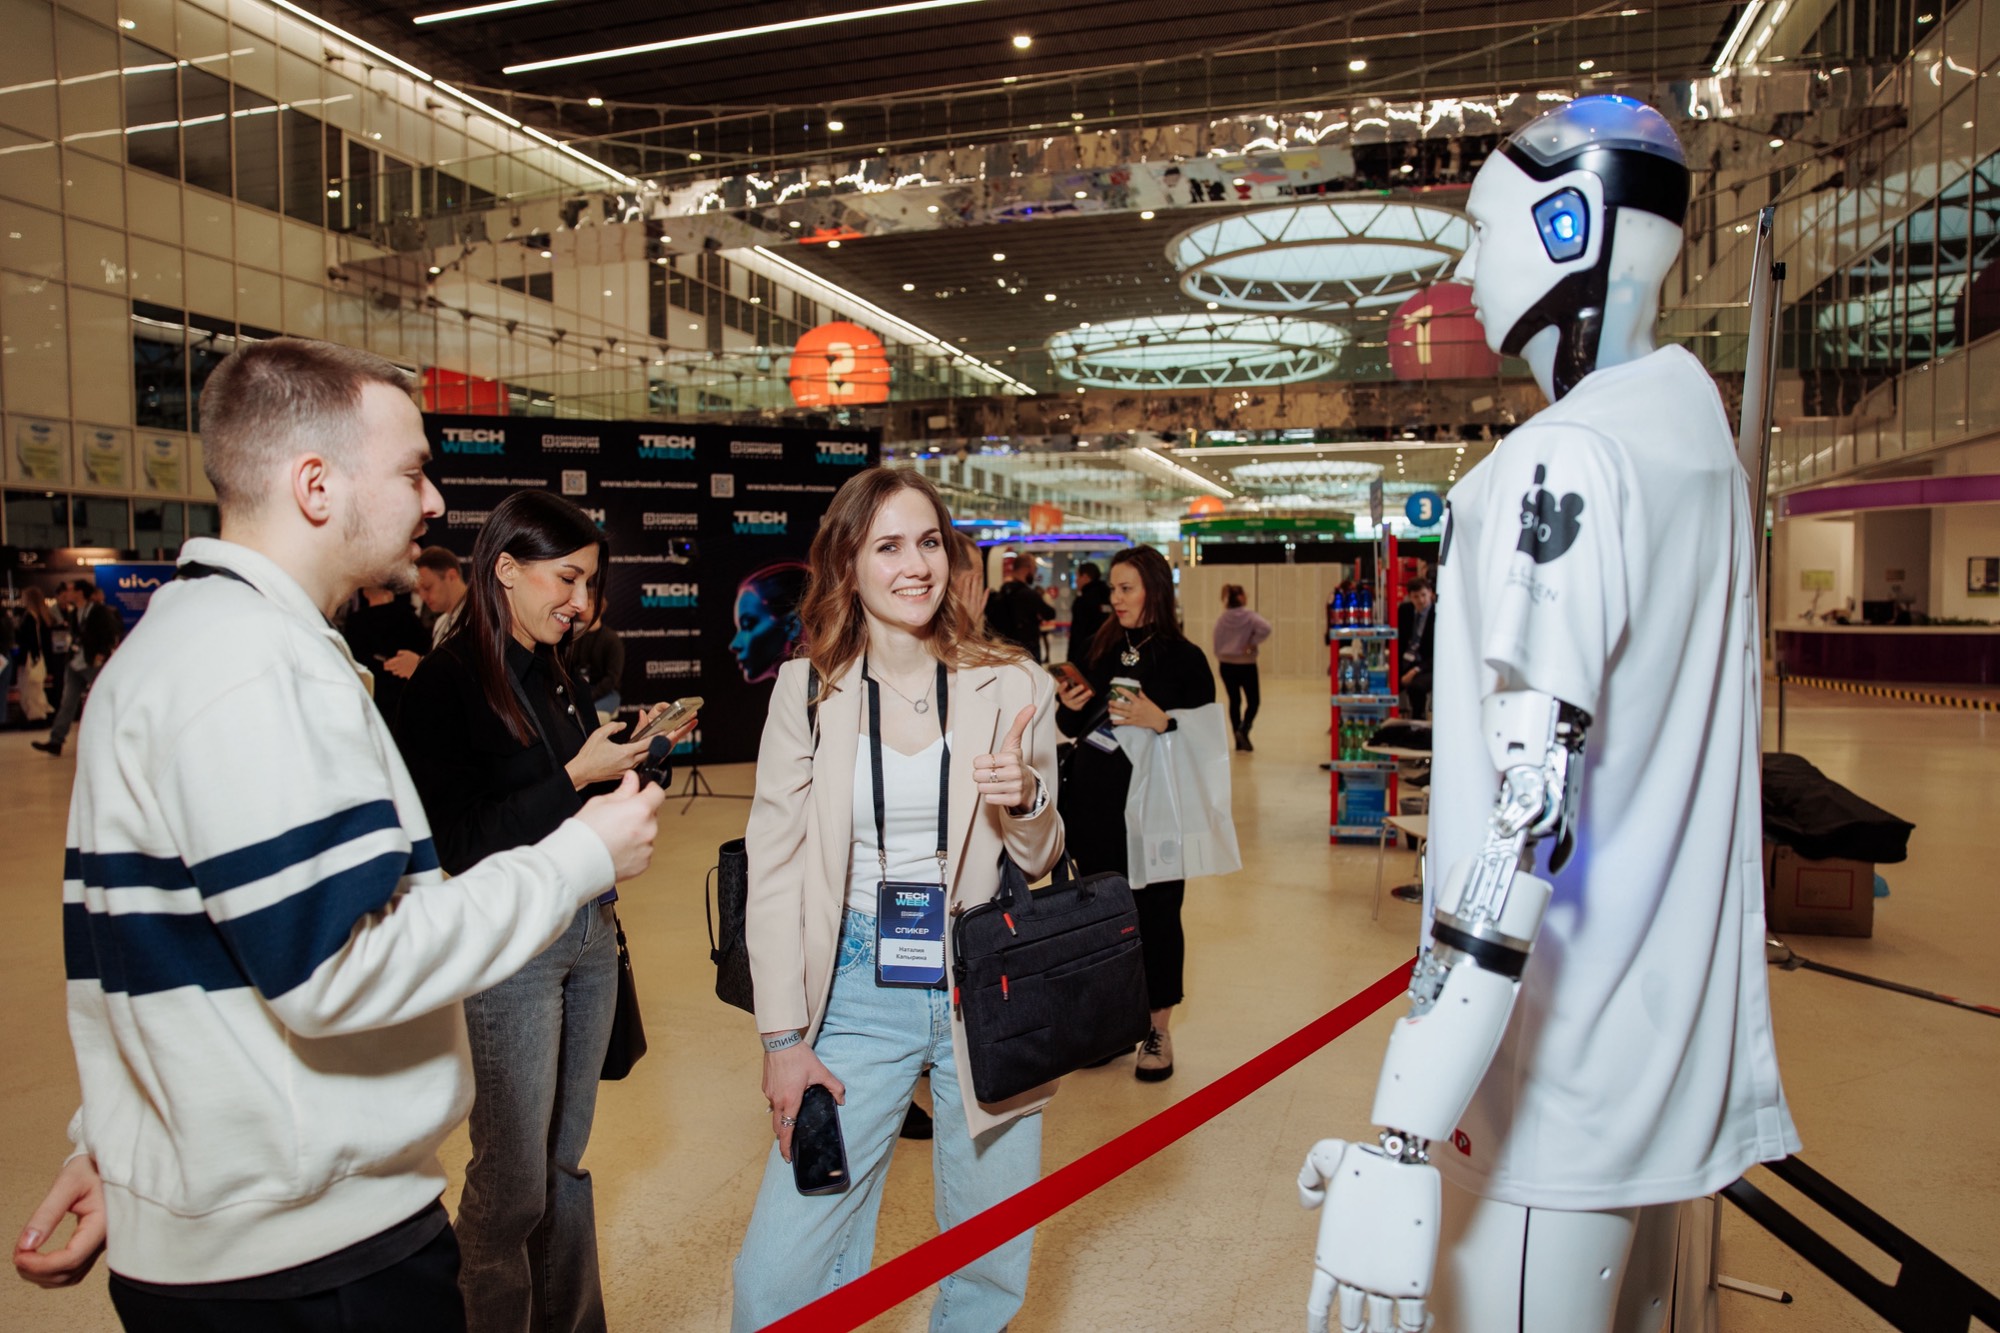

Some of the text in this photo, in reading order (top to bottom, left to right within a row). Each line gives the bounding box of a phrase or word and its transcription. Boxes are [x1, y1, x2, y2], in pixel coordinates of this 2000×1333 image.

[1403, 305, 1433, 365] 1
[827, 342, 855, 396] 2
[442, 428, 505, 443] TECH
[639, 434, 696, 449] TECH
[441, 440, 505, 455] WEEK
[638, 447, 696, 460] WEEK
[816, 441, 868, 455] TECH
[815, 453, 868, 465] WEEK
[1419, 498, 1432, 520] 3
[733, 510, 787, 524] TECH
[732, 522, 787, 535] WEEK
[641, 584, 699, 597] TECH
[640, 595, 699, 608] WEEK
[896, 891, 930, 900] TECH
[895, 899, 930, 907] WEEK
